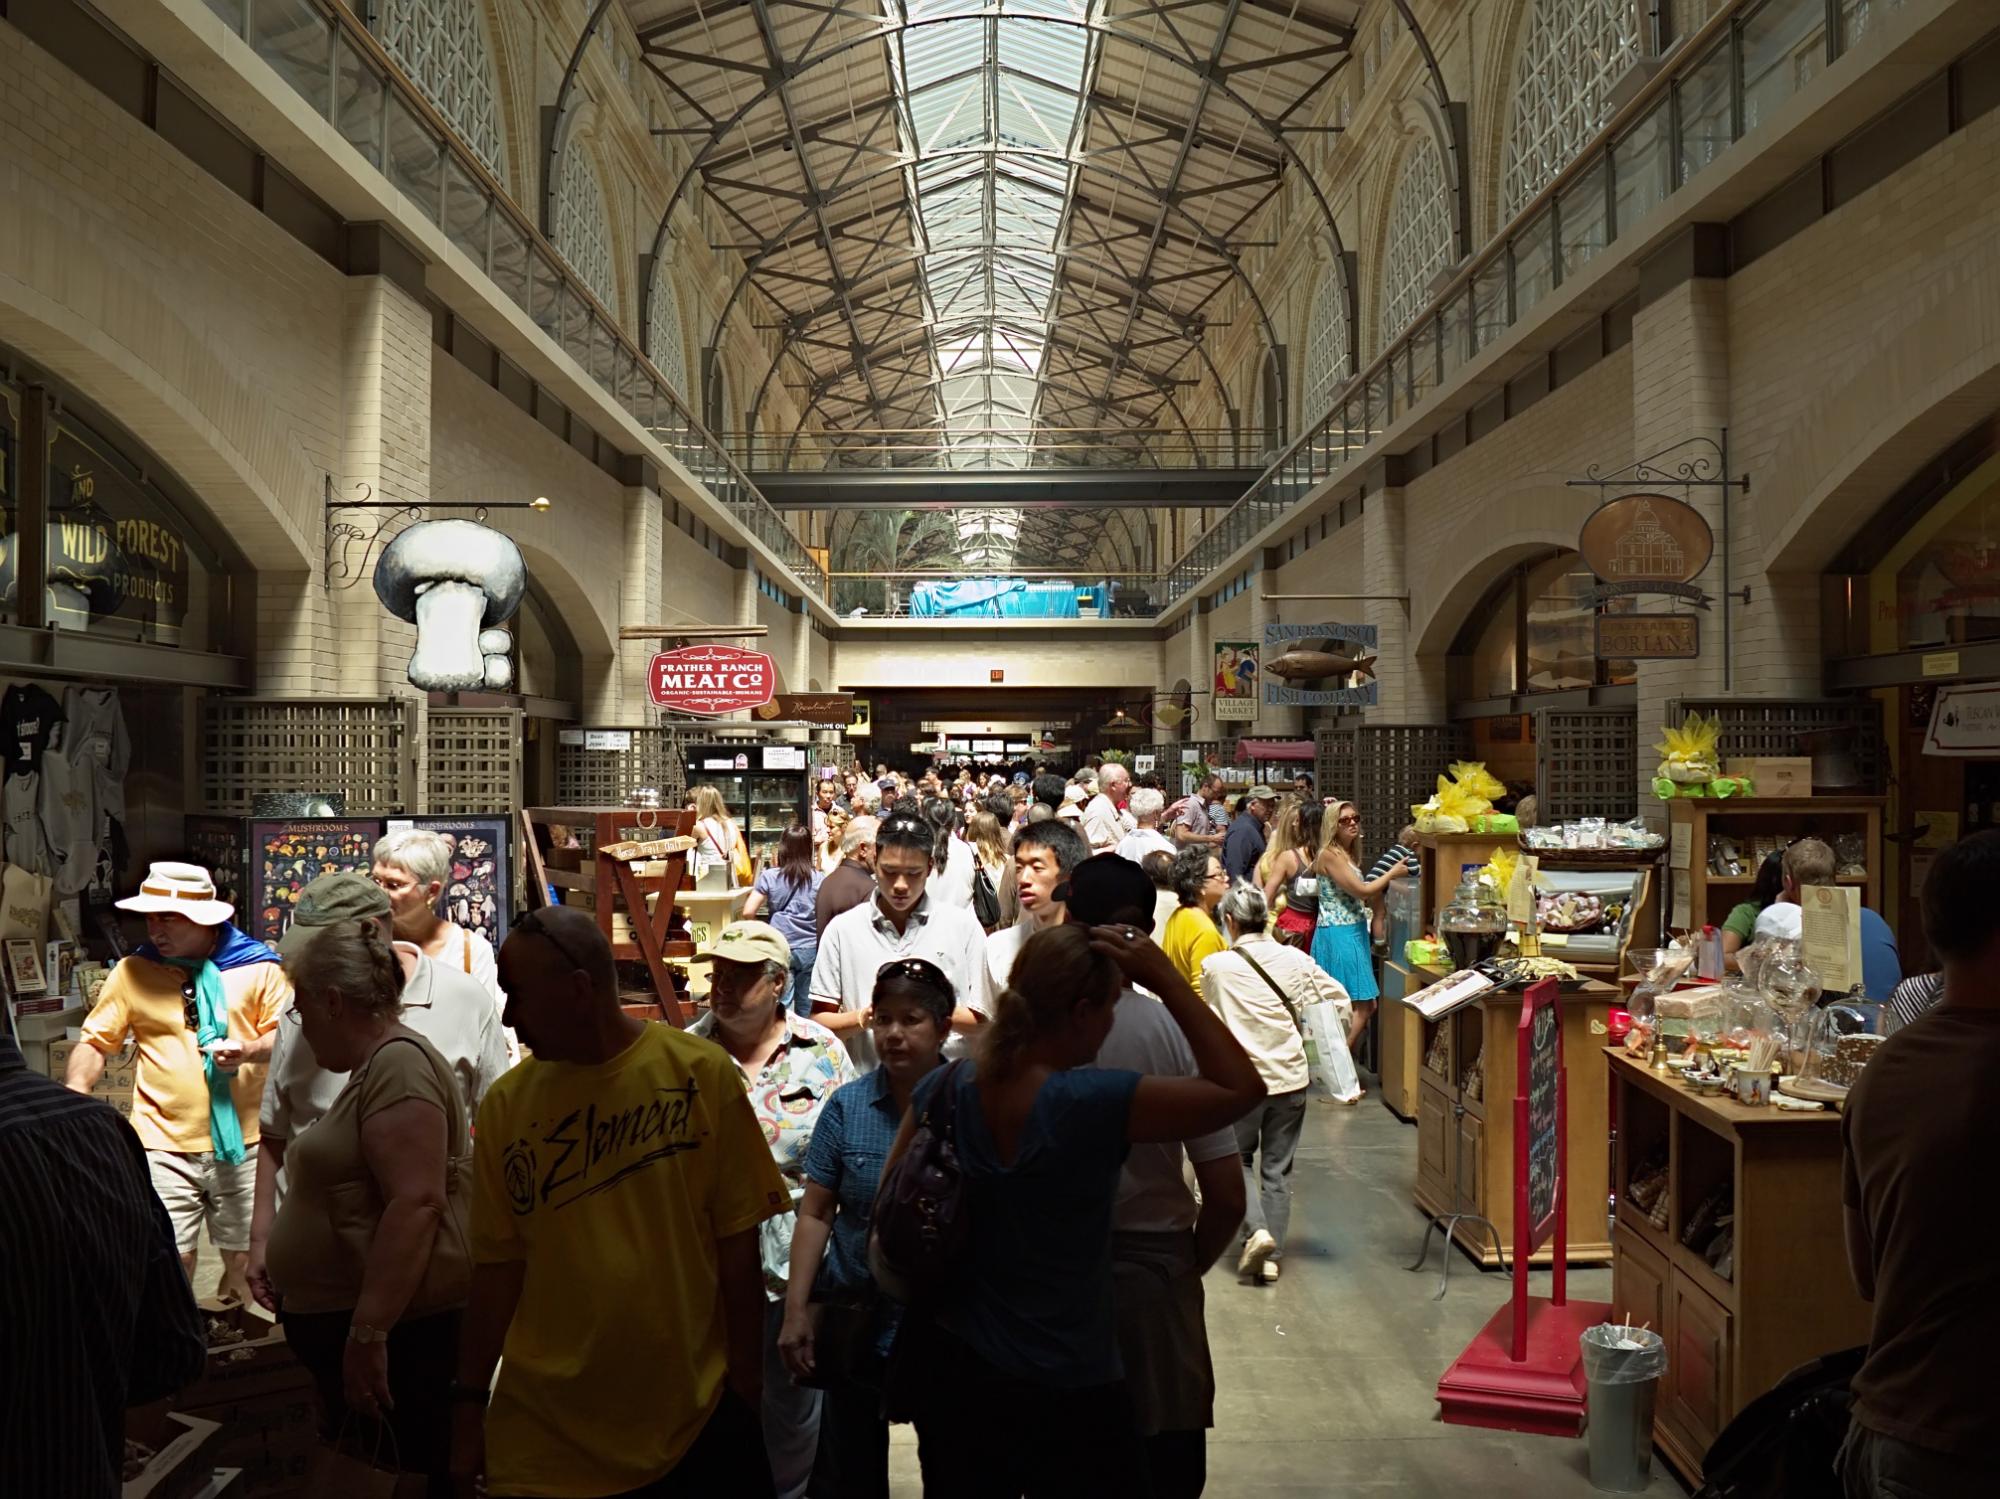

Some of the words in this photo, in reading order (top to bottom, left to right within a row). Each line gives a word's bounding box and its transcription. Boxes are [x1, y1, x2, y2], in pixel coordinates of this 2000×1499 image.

[71, 477, 95, 503] AND
[60, 513, 109, 564] WILD
[116, 519, 181, 573] FOREST
[113, 573, 175, 604] PRODUCTS
[1265, 626, 1294, 644] SAN
[1299, 626, 1376, 645] FRANCISCO
[1601, 635, 1695, 652] BORIANA
[660, 664, 713, 672] PRATHER
[721, 664, 763, 672] RANCH
[661, 674, 728, 689] MEAT
[1266, 682, 1299, 703] FISH
[1303, 683, 1375, 704] COMPANY
[1218, 699, 1256, 707] VILLAGE
[835, 722, 847, 730] OIL
[288, 823, 350, 833] MUSHROOMS
[417, 821, 475, 830] MUSHROOMS
[541, 1076, 699, 1204] Element
